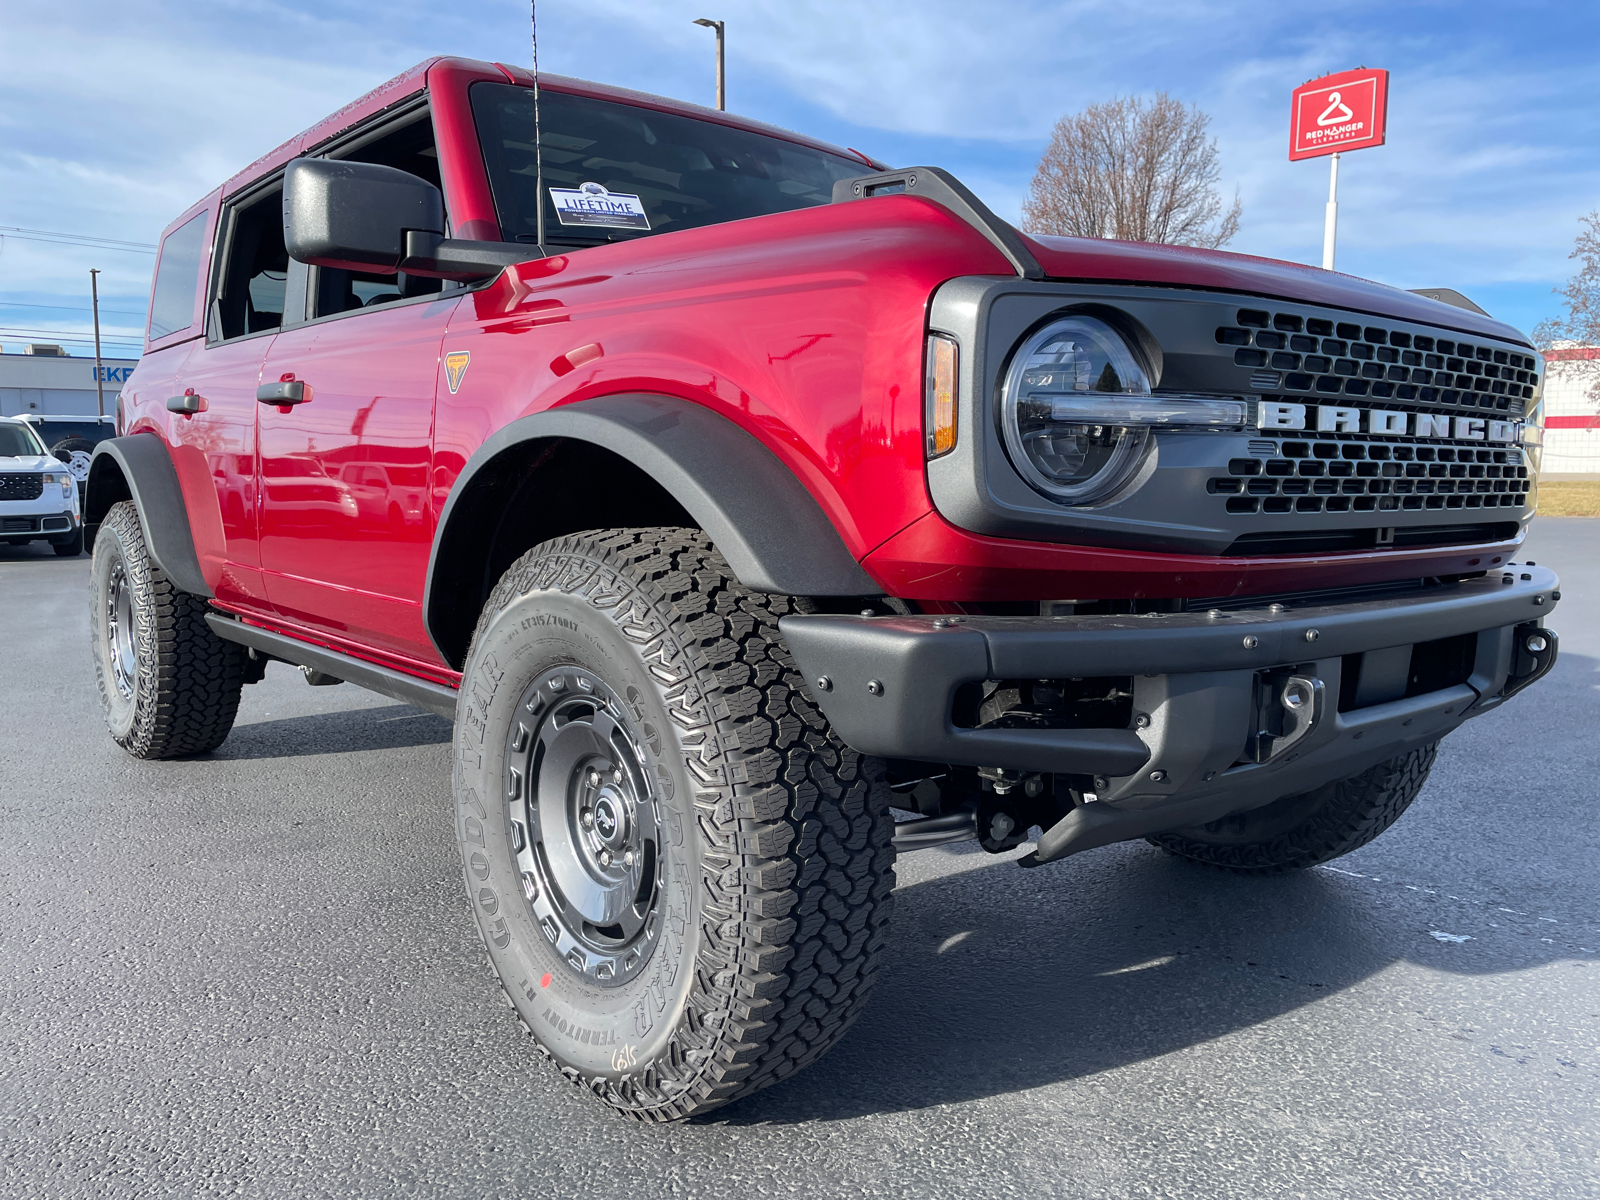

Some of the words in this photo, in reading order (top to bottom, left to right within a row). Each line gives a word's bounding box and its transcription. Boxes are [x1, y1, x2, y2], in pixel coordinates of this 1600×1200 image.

[1313, 131, 1355, 144] CLEANERS
[1324, 122, 1363, 135] HANGER
[564, 198, 634, 213] LIFETIME
[1257, 400, 1514, 442] BRONCO
[454, 652, 511, 950] GOODYEAR
[518, 979, 538, 1003] RT
[541, 1007, 616, 1047] TERRITORY
